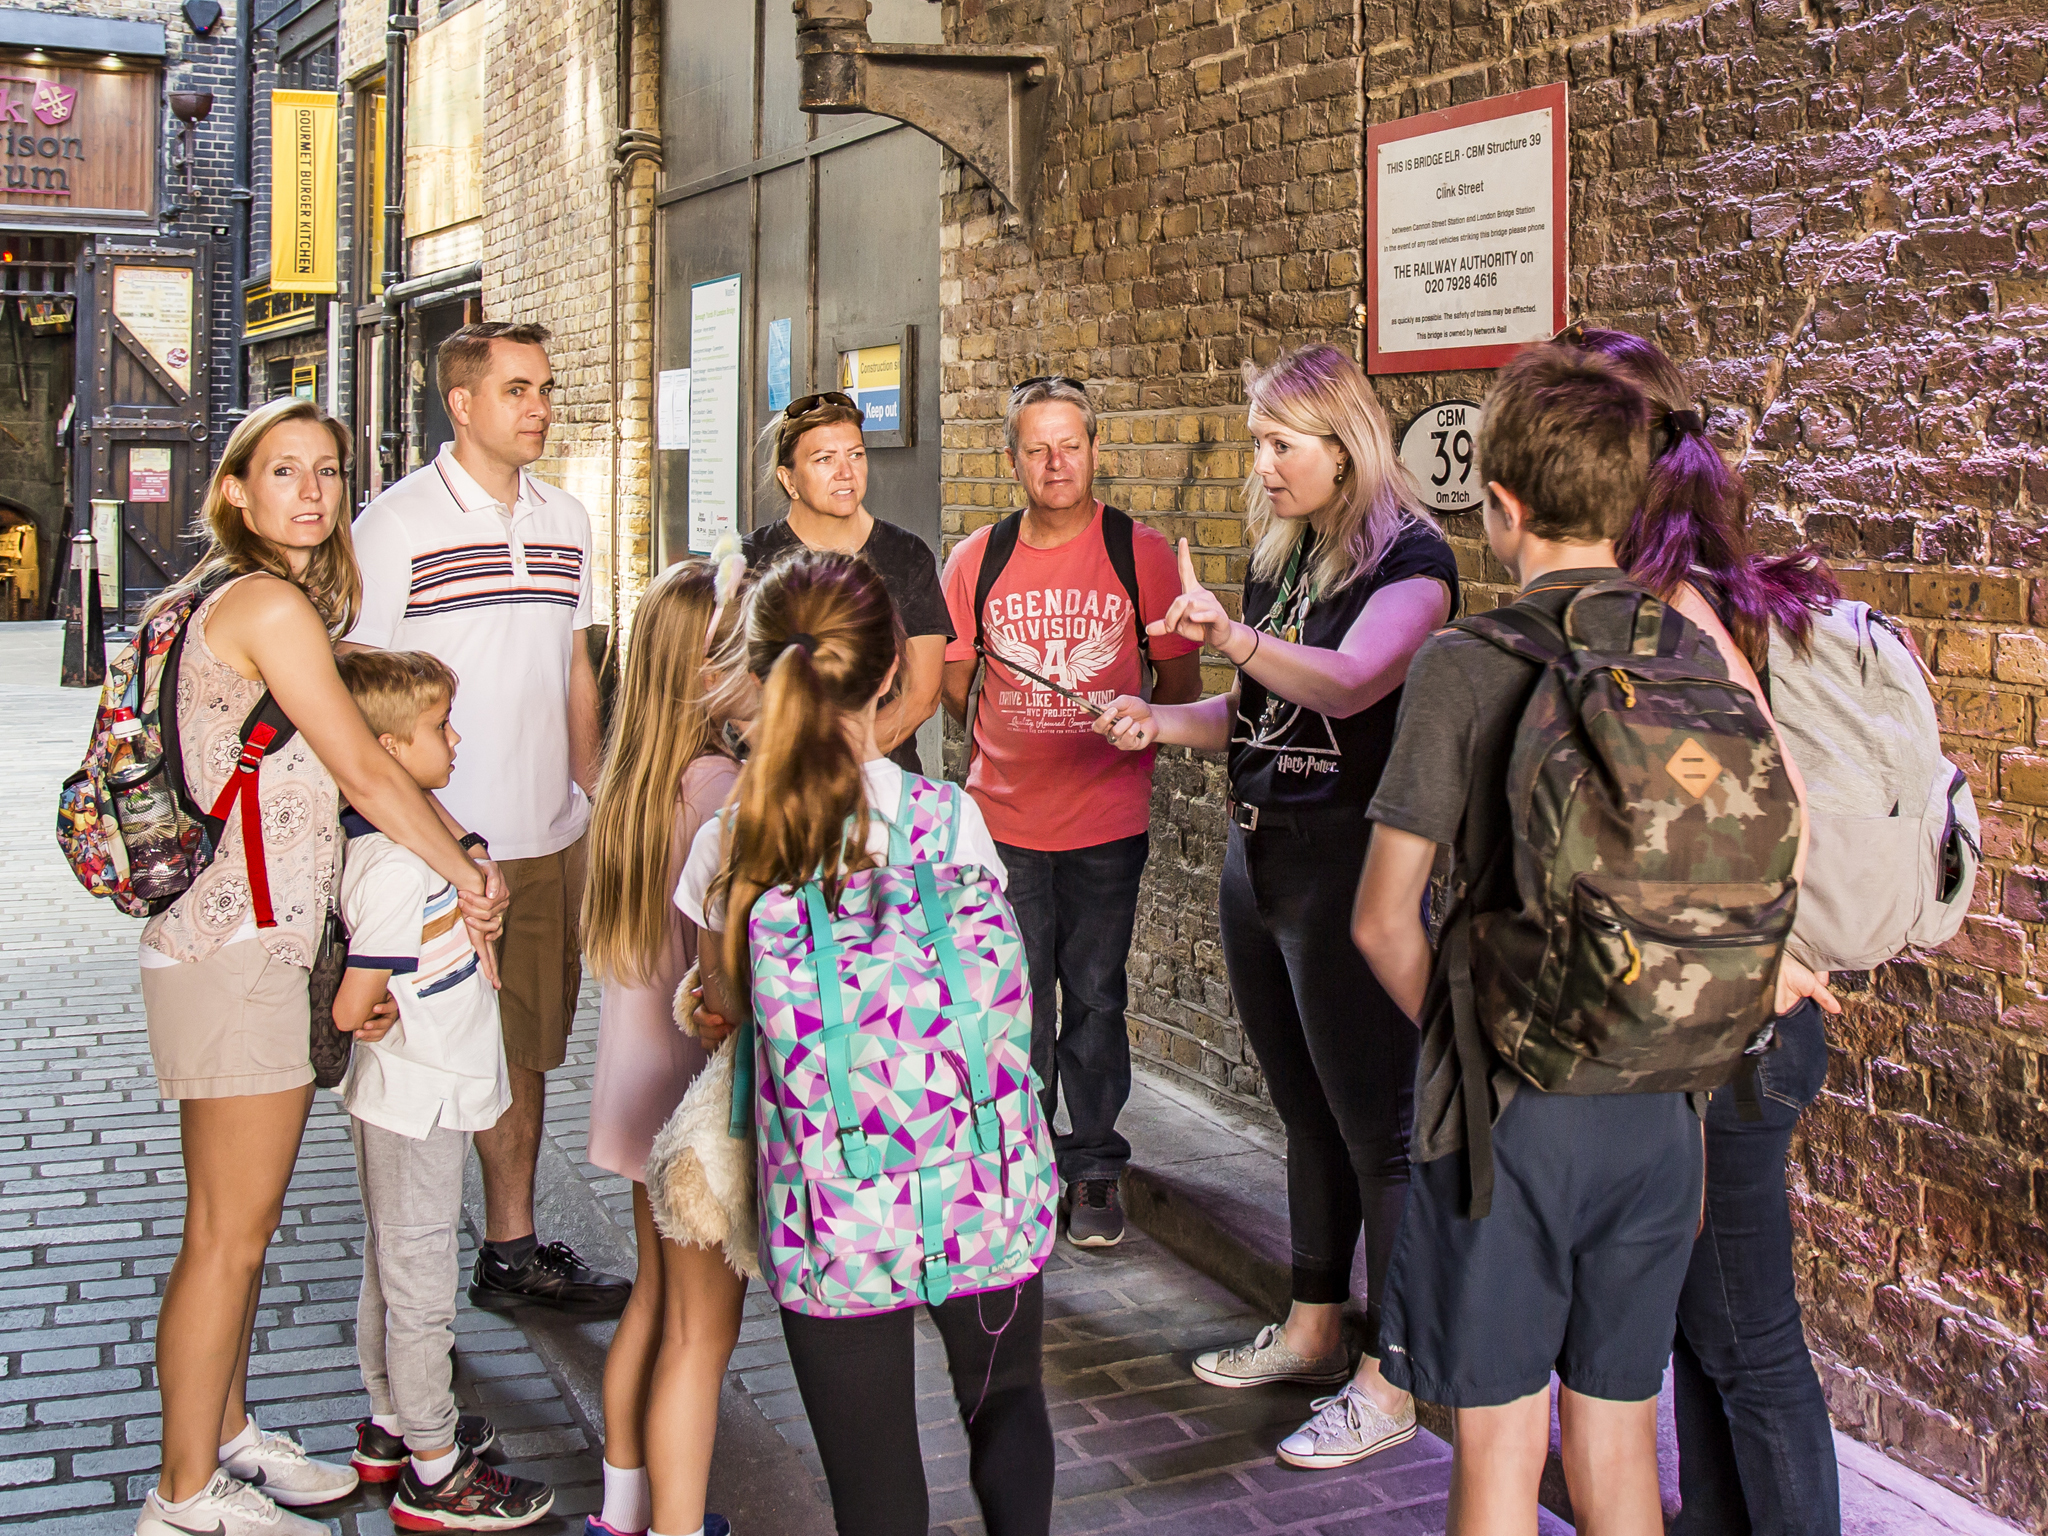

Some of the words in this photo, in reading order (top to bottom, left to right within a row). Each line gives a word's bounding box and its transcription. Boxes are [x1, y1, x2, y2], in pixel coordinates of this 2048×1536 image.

[0, 89, 28, 123] k
[0, 128, 85, 161] ison
[299, 109, 312, 167] GOURMET
[1387, 161, 1404, 175] THIS
[1404, 159, 1413, 171] IS
[1414, 153, 1443, 170] BRIDGE
[1444, 149, 1461, 163] ELR
[1466, 144, 1486, 159] CBM
[1487, 137, 1528, 155] Structure
[1529, 132, 1542, 146] 39
[0, 164, 70, 190] um
[1436, 185, 1457, 200] Clink
[1458, 180, 1485, 196] Street
[299, 170, 312, 217] BURGER
[1391, 225, 1412, 235] between
[1412, 222, 1431, 231] Cannon
[1431, 219, 1447, 228] Street
[1447, 216, 1465, 226] Station
[1466, 214, 1476, 223] and
[1477, 212, 1496, 222] London
[1497, 209, 1515, 218] Bridge
[1516, 205, 1536, 215] Station
[298, 221, 312, 274] KITCHEN
[1389, 243, 1397, 252] the
[1397, 241, 1411, 251] event
[1411, 240, 1417, 248] of
[1417, 240, 1426, 249] any
[1427, 237, 1438, 247] road
[1438, 235, 1459, 245] vehicles
[1460, 232, 1480, 241] striking
[1480, 230, 1490, 239] this
[1490, 228, 1508, 238] bridge
[1508, 225, 1527, 236] please
[1527, 223, 1545, 233] phone
[1394, 264, 1411, 279] THE
[1413, 258, 1457, 277] RAILWAY
[1459, 250, 1518, 272] AUTHORITY
[1520, 250, 1534, 264] on
[1424, 278, 1444, 294] 020
[1446, 275, 1471, 291] 7928
[1473, 272, 1498, 288] 4616
[1397, 316, 1415, 325] quickly
[1443, 312, 1453, 320] The
[1453, 311, 1469, 320] safety
[1470, 309, 1476, 318] of
[1476, 309, 1491, 317] trains
[1492, 308, 1504, 316] may
[1504, 307, 1512, 315] be
[1416, 332, 1427, 340] This
[1427, 331, 1443, 340] bridge
[1443, 330, 1448, 338] is
[1449, 329, 1466, 337] owned
[1466, 329, 1473, 338] by
[1473, 326, 1496, 336] Network
[1496, 325, 1507, 334] Rail
[860, 361, 894, 375] Construction
[865, 402, 884, 421] Keep
[884, 401, 898, 417] out
[1437, 408, 1466, 427] CBM
[1430, 429, 1474, 487] 39
[1436, 491, 1449, 503] 0m
[1451, 490, 1470, 503] 21ch
[988, 588, 1135, 628] EGENDARY
[1001, 617, 1104, 646] DIVISION
[1036, 639, 1074, 692] A
[999, 690, 1023, 706] DRIVE
[1025, 692, 1053, 708] LIKE
[1087, 689, 1115, 705] WIND
[1008, 716, 1034, 729] Quality
[1026, 708, 1041, 717] NYC
[1042, 708, 1078, 718] PROJECT
[1277, 754, 1307, 774] Harry
[1305, 755, 1338, 779] Potter
[210, 1477, 224, 1497] NIKE
